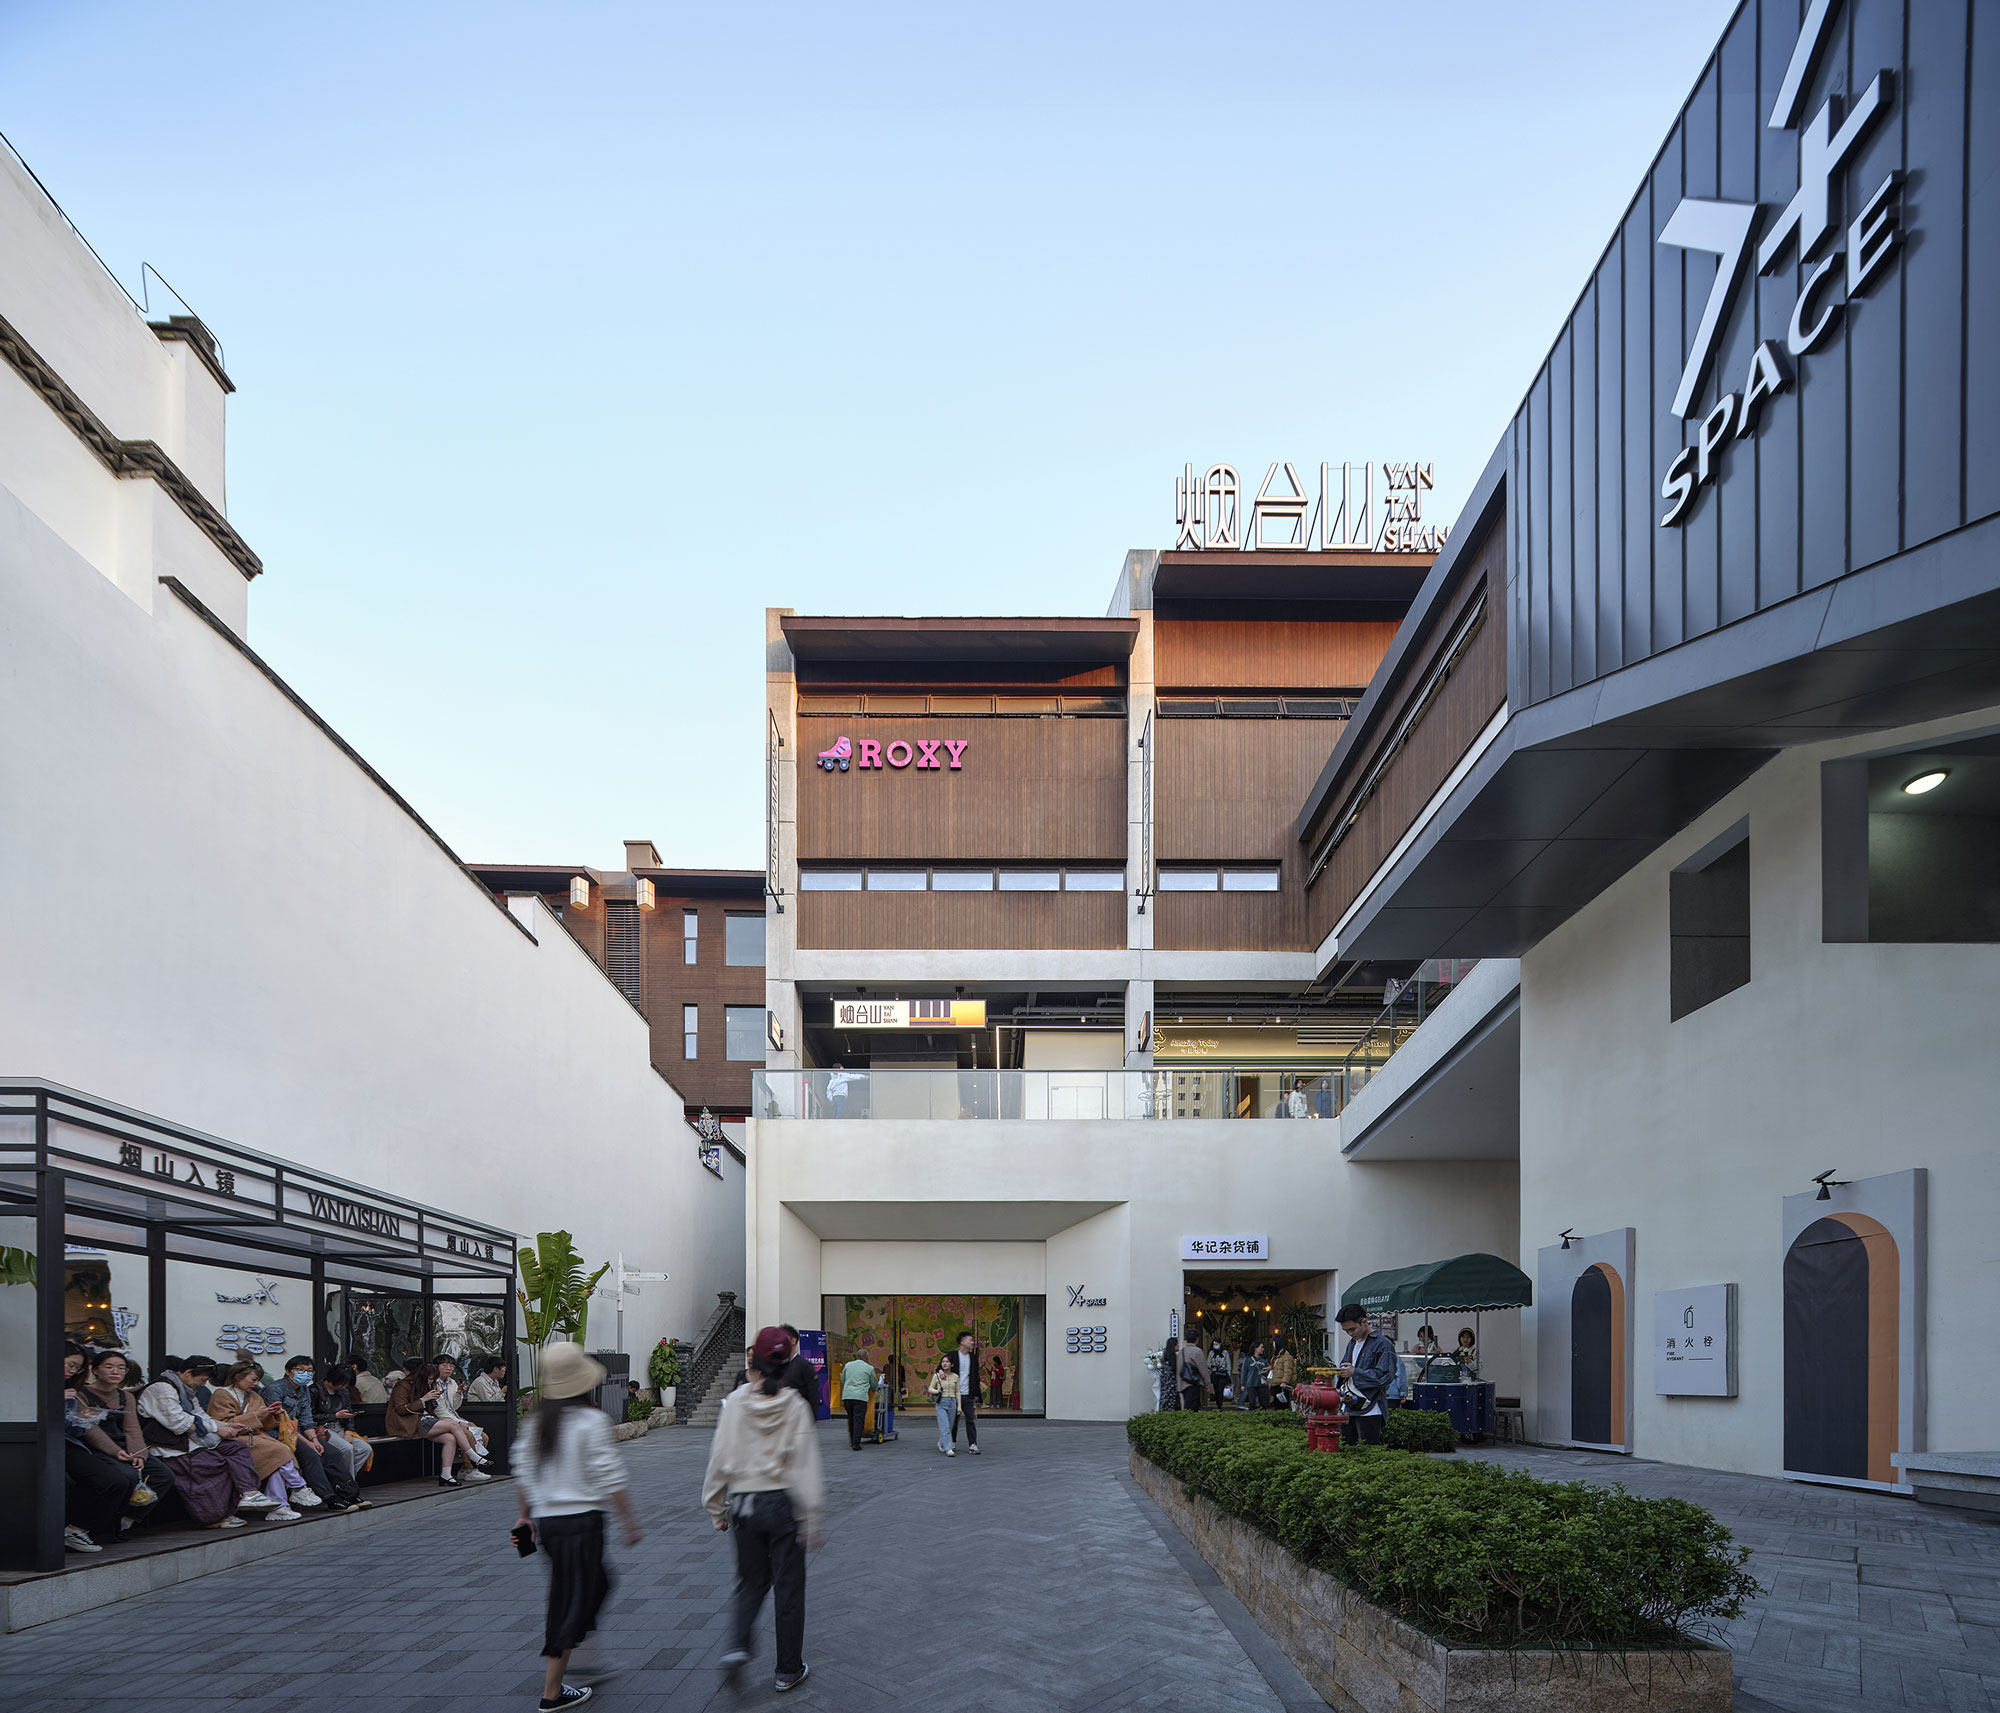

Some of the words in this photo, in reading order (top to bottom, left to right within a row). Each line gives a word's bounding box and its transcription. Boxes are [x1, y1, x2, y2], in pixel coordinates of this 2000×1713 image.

[1660, 169, 1906, 528] SPACE
[1383, 462, 1434, 490] YAN
[1384, 525, 1453, 551] SHAN
[859, 739, 968, 769] ROXY
[1199, 1039, 1219, 1048] Today
[120, 1141, 236, 1196] 烟山入镜
[307, 1192, 400, 1237] YANTAISHAN
[1191, 1240, 1260, 1254] 华记杂货铺
[1086, 1298, 1107, 1307] SPACE
[1666, 1335, 1713, 1349] 消火栓
